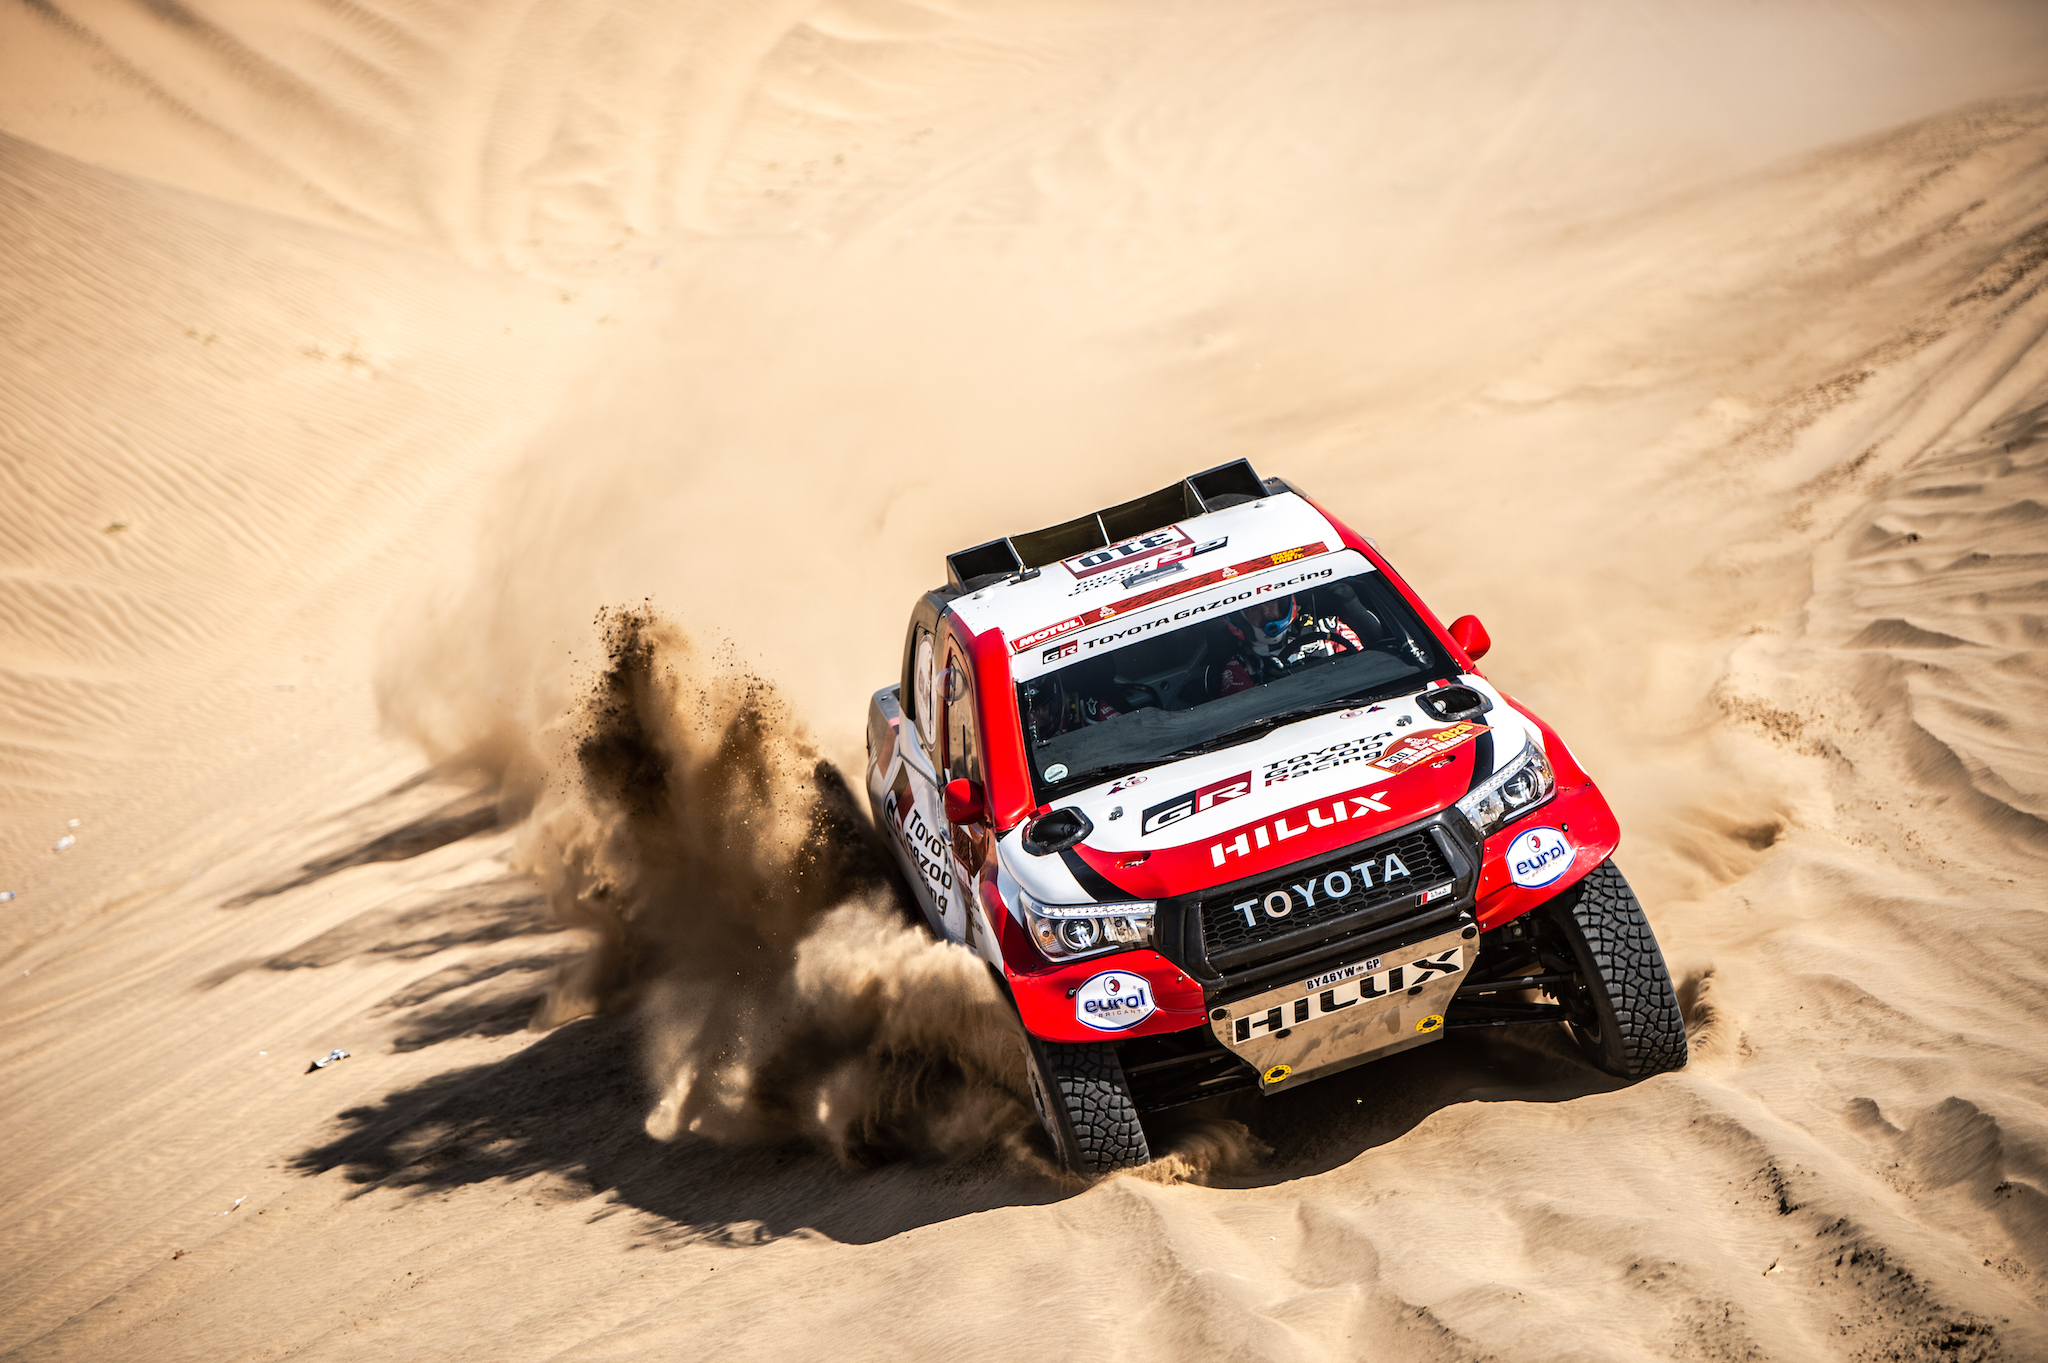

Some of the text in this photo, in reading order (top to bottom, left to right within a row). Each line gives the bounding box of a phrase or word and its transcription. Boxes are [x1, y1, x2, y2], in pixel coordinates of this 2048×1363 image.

[1078, 532, 1174, 568] 310
[1018, 619, 1080, 648] MOTUL
[1043, 568, 1333, 664] GR TOYOTA GAZOO Racing
[1263, 731, 1393, 770] TOYOTA
[1402, 733, 1473, 765] SAUDI ARABIA
[1432, 724, 1474, 741] 2020
[1264, 741, 1383, 779] GAZOO
[1265, 751, 1382, 787] Racing
[1384, 751, 1409, 764] 310
[1144, 781, 1250, 833] GR
[1210, 791, 1391, 868] HILUX
[1516, 840, 1566, 875] eurol
[1233, 853, 1411, 927] TOYOTA
[1307, 958, 1380, 990] BY46YW GP
[1084, 988, 1147, 1013] eurol
[1235, 948, 1460, 1042] HILUX
[1084, 1008, 1149, 1020] LUBRICANTS
